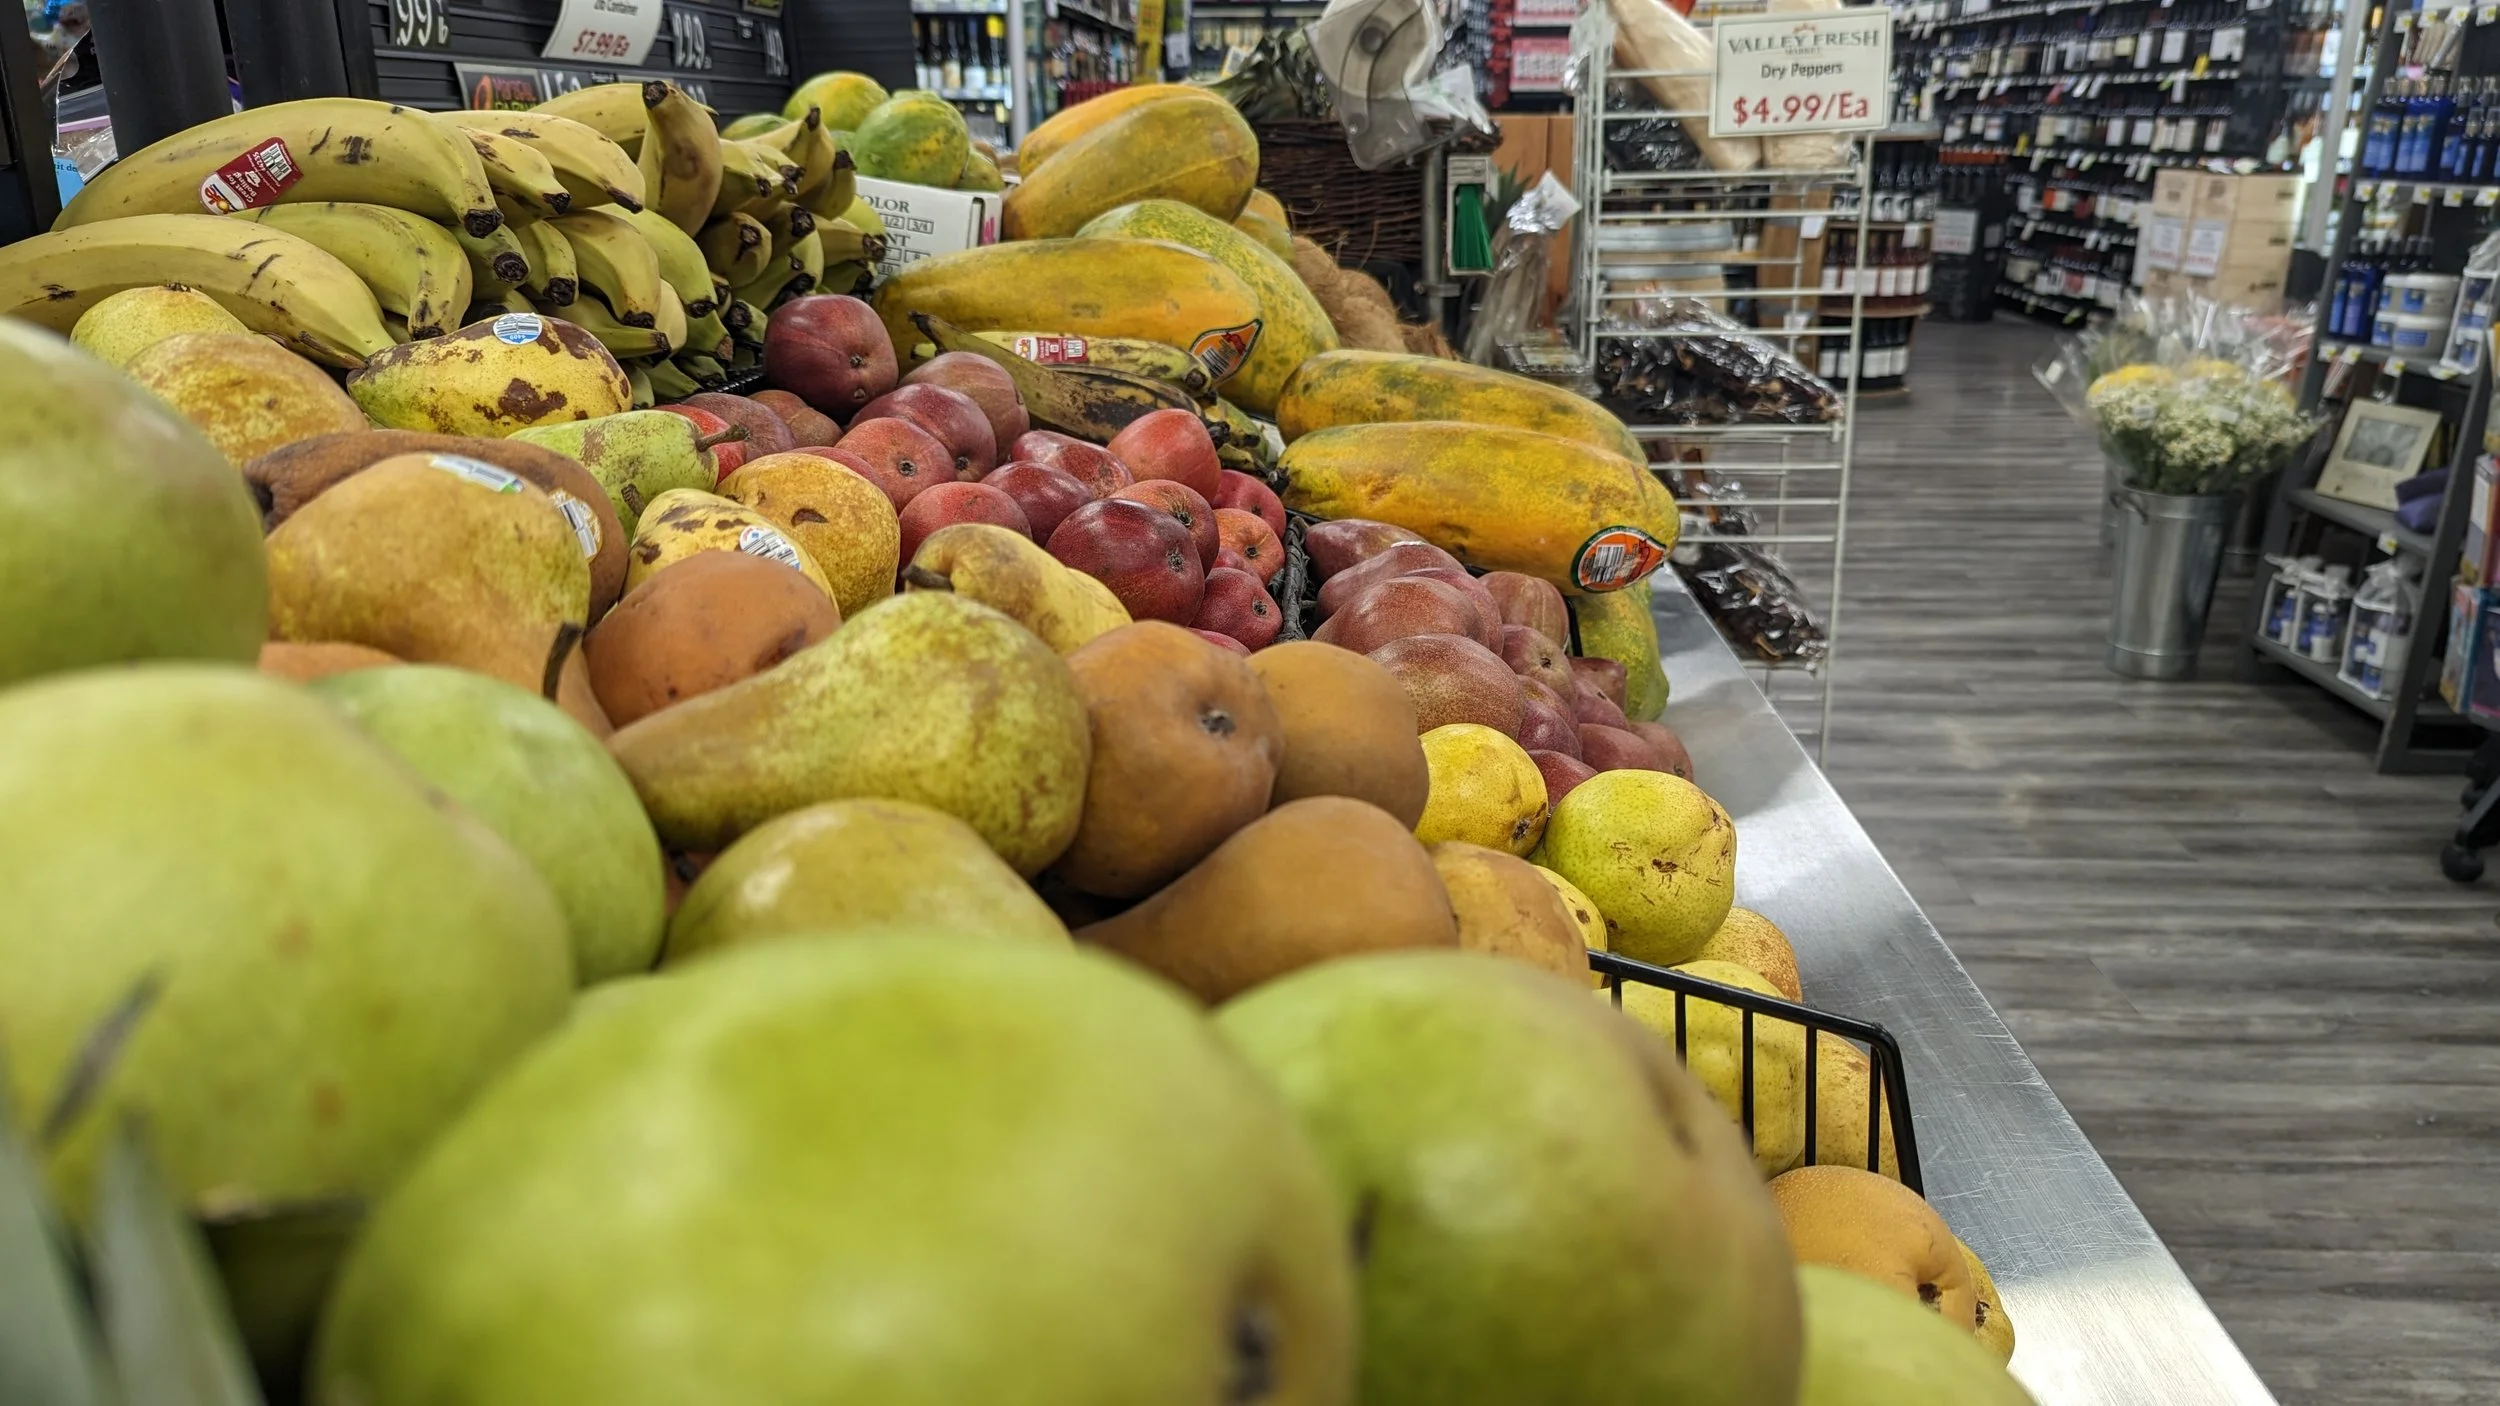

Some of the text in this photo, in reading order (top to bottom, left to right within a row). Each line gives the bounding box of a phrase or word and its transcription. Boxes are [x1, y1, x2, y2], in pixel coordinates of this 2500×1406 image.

[1728, 30, 1879, 54] VALLEY FRESH
[1760, 62, 1843, 80] Dry Peppers
[1732, 91, 1869, 128] $4.99/Ea
[225, 173, 254, 204] Great for
[884, 216, 900, 227] 1/2
[912, 220, 929, 232] 3/4
